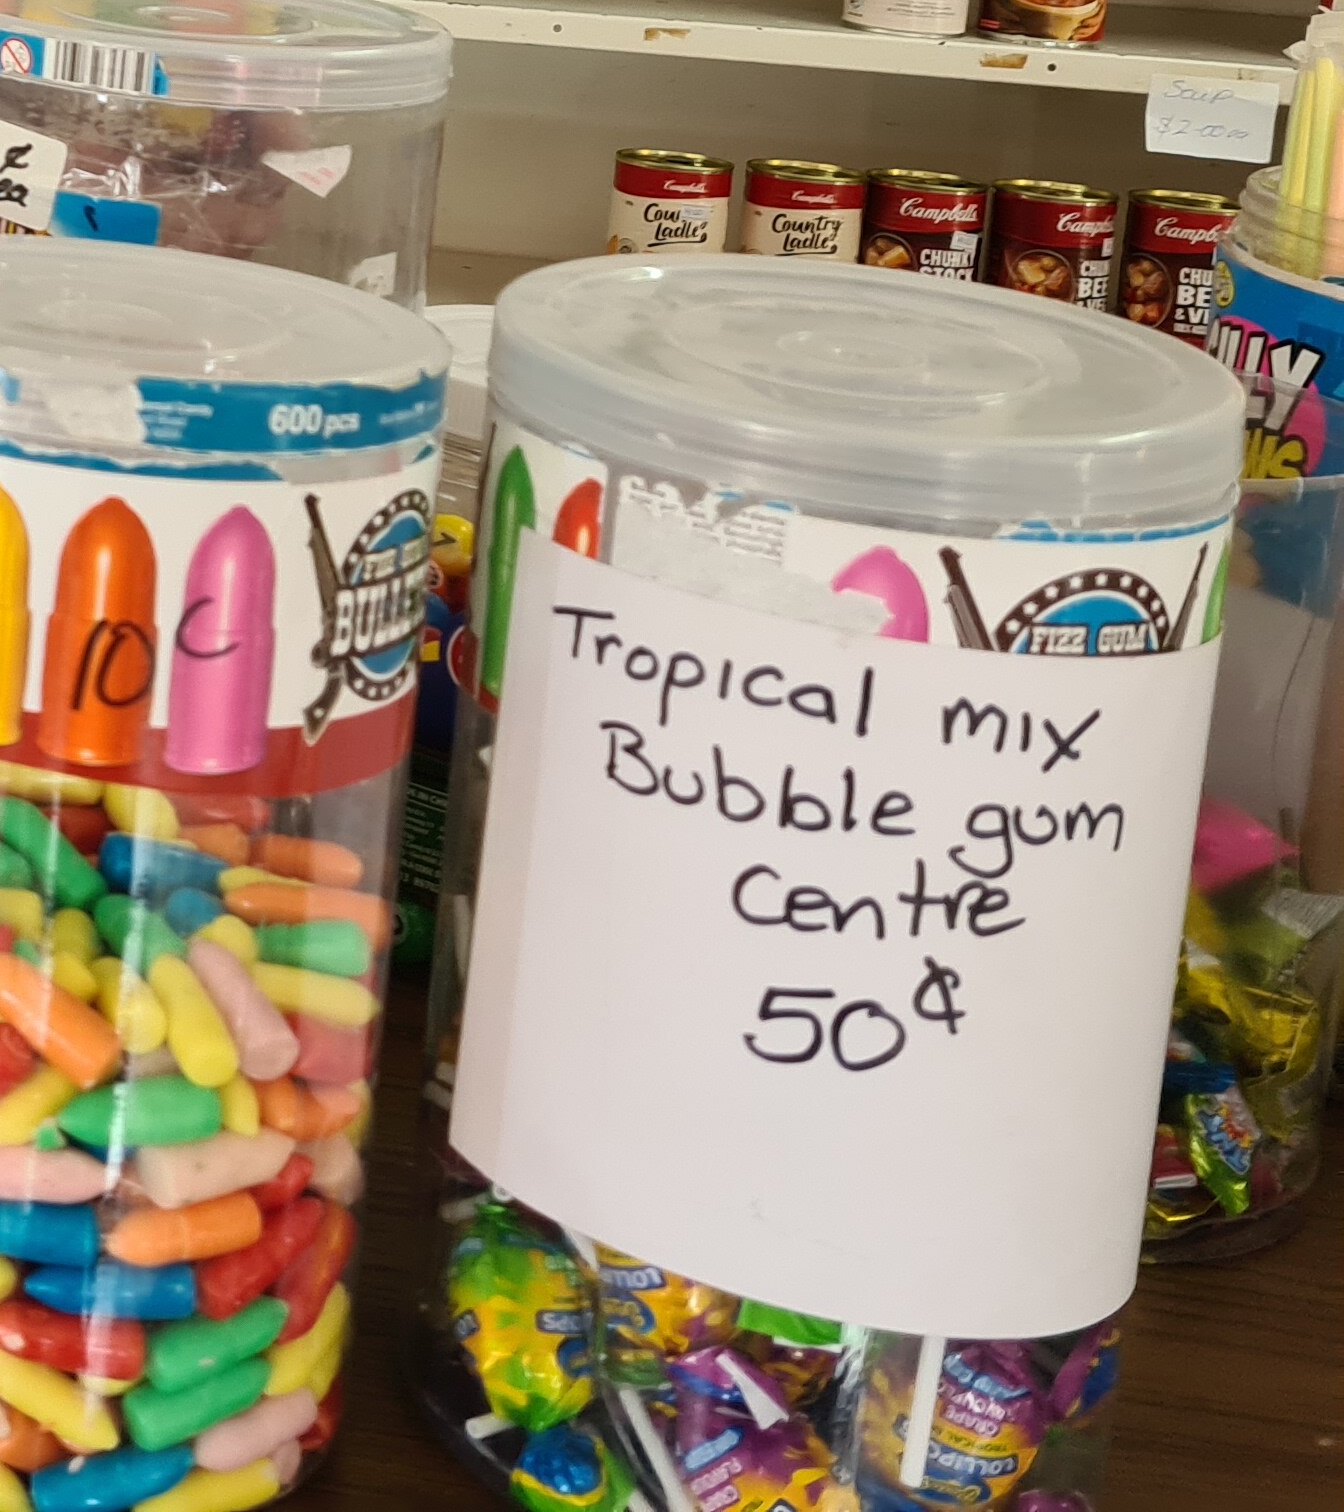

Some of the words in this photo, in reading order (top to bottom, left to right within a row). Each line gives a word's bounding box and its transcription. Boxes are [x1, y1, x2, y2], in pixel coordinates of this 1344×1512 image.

[654, 220, 708, 242] Ladle
[771, 213, 843, 239] Country
[782, 233, 837, 253] Ladle
[268, 403, 322, 435] 600
[323, 412, 360, 438] pcs
[1029, 624, 1088, 655] FIZZ
[1097, 622, 1148, 653] GUM
[551, 604, 876, 738] Tropical
[941, 695, 1102, 773] mix
[600, 721, 916, 839] Bubble
[948, 799, 1126, 880] gum
[731, 857, 1027, 941] Centre
